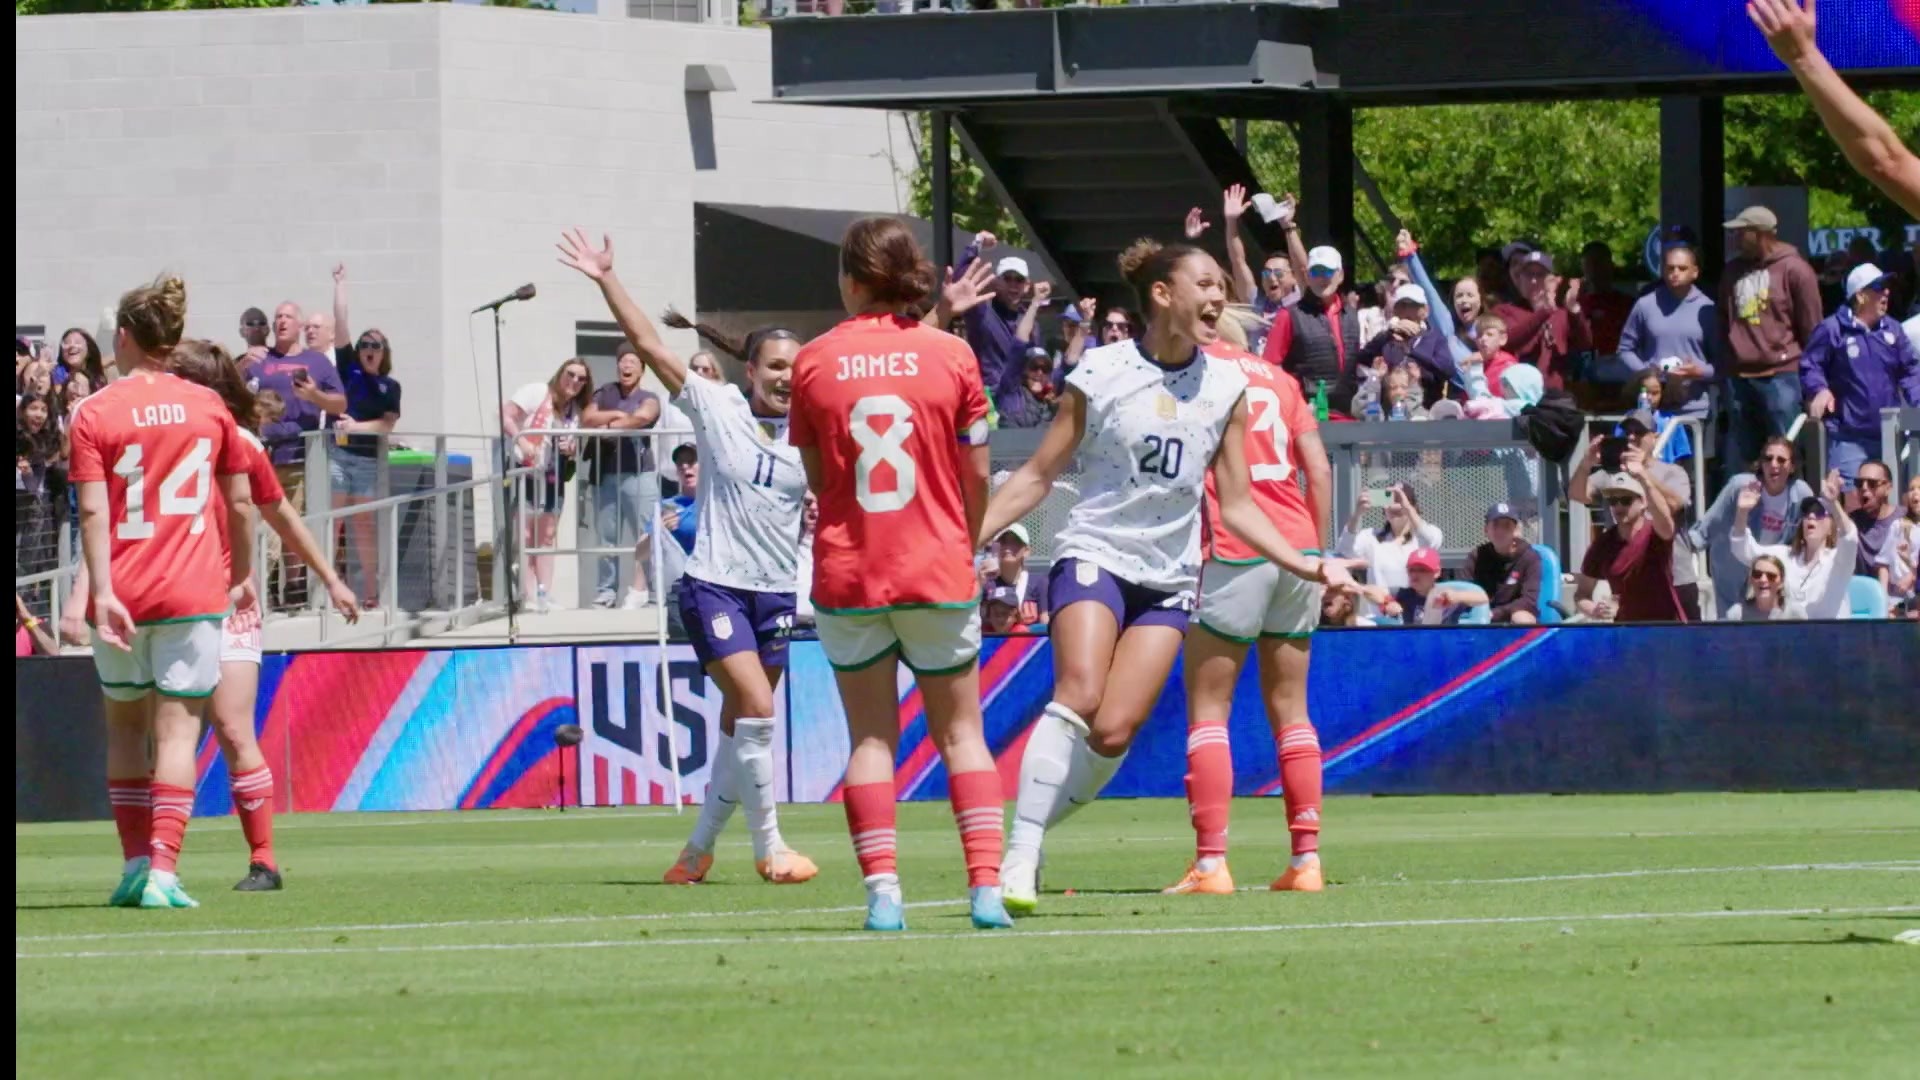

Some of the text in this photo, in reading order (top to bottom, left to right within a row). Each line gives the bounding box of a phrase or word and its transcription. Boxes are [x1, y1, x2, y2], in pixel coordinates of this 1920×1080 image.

[836, 352, 919, 381] JAMES
[132, 403, 186, 427] LADD
[752, 453, 776, 488] 11
[850, 395, 916, 513] 8
[1140, 435, 1184, 479] 20
[113, 437, 212, 540] 14
